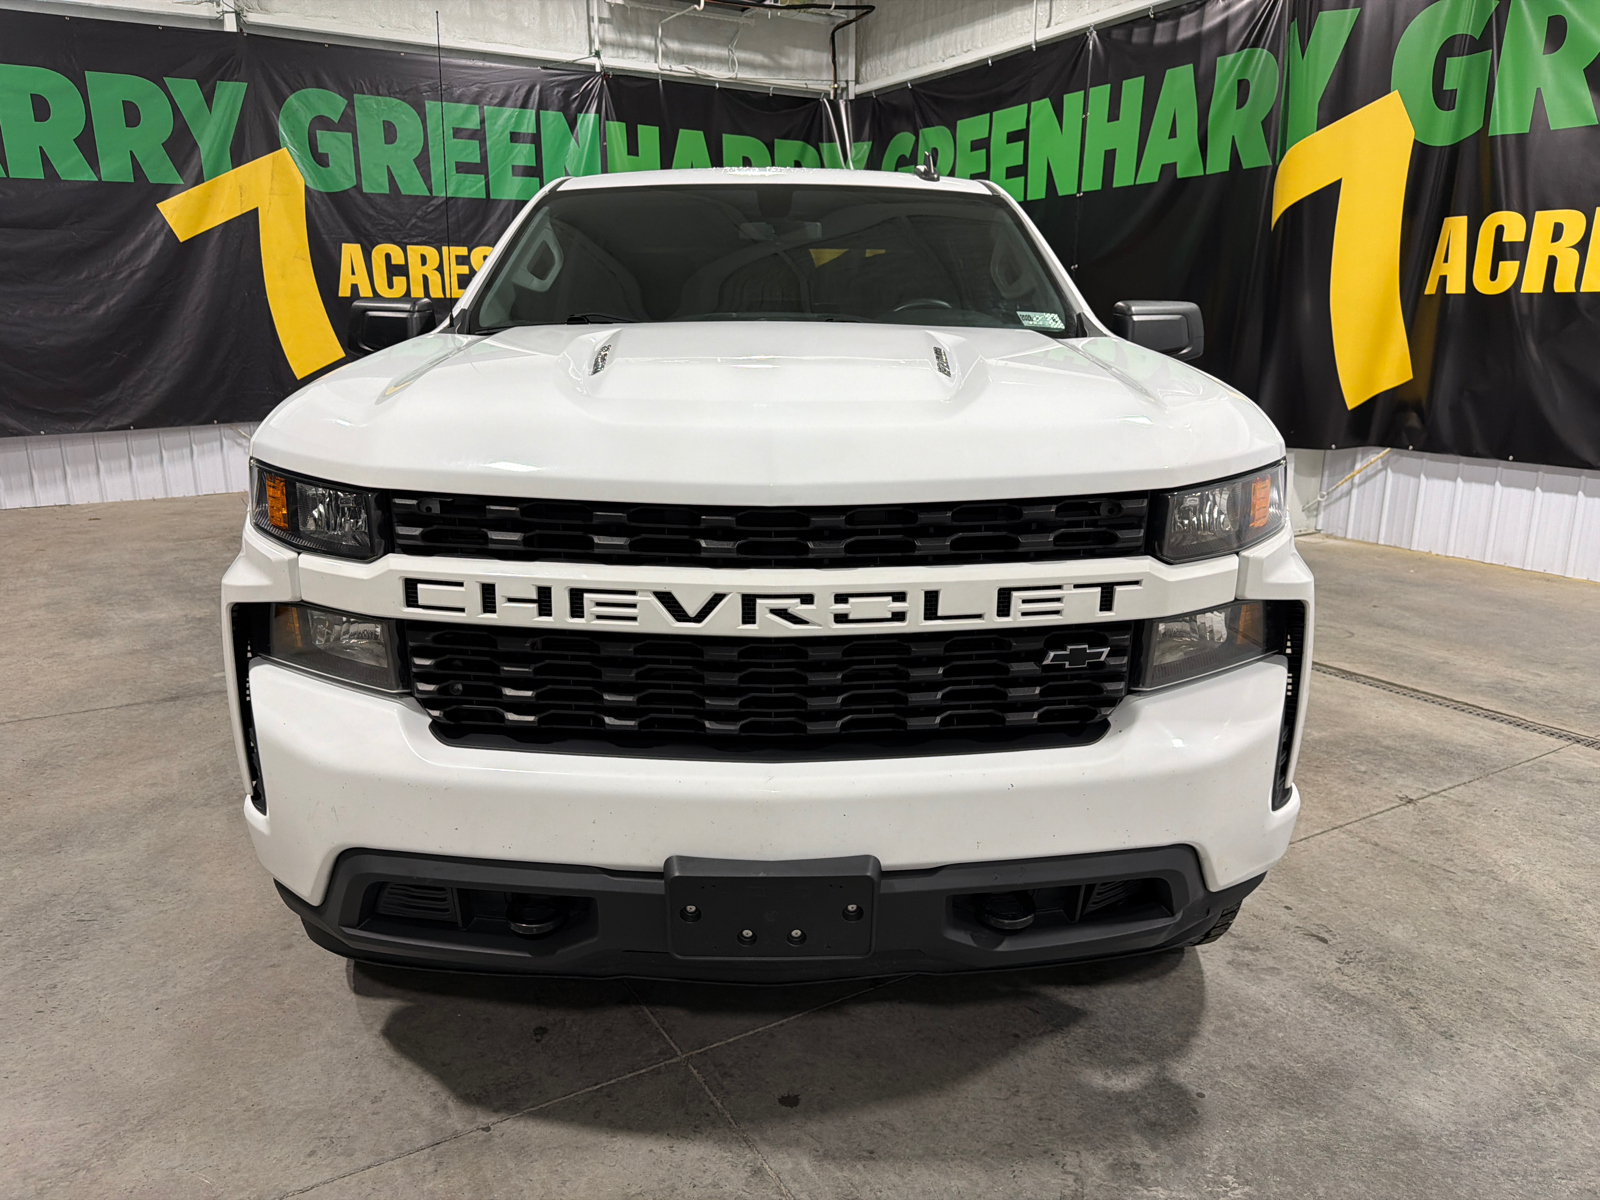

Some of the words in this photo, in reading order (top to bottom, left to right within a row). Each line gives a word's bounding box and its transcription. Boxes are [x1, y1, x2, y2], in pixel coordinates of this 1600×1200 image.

[0, 62, 248, 185] RRY
[279, 88, 600, 200] GREEN
[157, 147, 346, 380] 7
[1271, 89, 1415, 410] 7
[402, 578, 1142, 628] CHEVROLET
